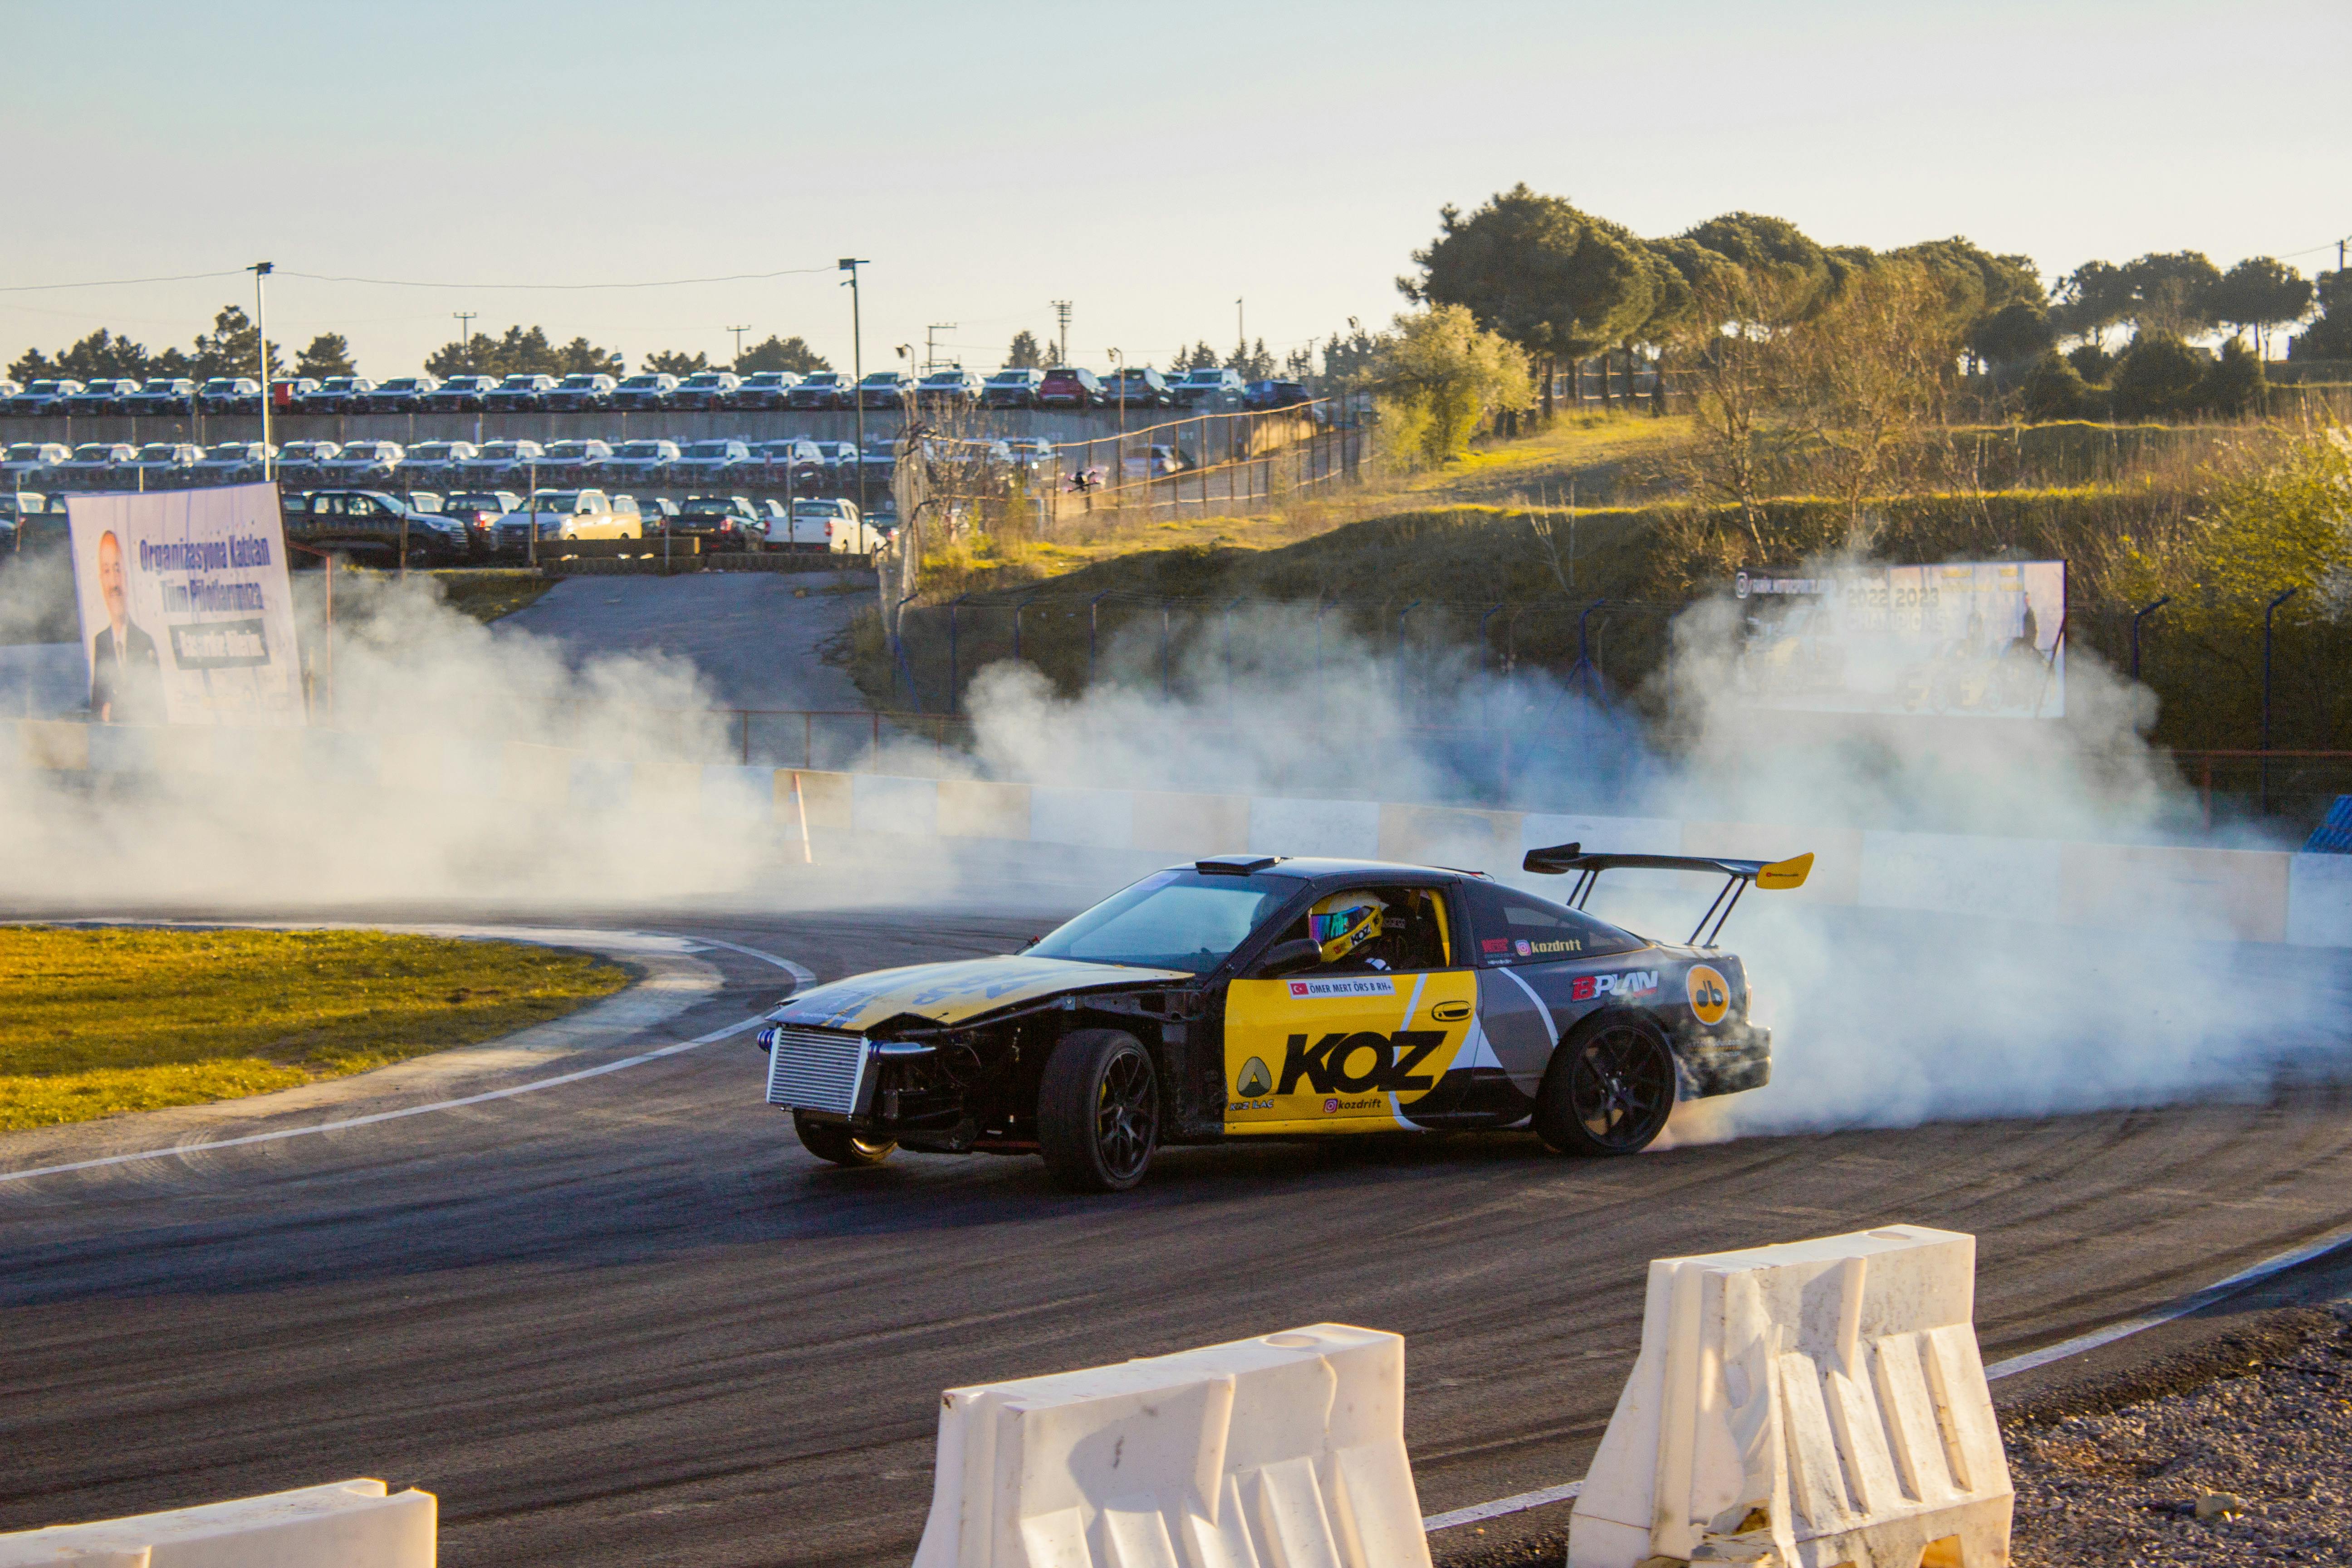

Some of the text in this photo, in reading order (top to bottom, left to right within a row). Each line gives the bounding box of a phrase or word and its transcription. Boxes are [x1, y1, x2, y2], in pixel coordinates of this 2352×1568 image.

[1847, 588, 1888, 608] 2022
[1896, 587, 1940, 608] 2023
[1351, 924, 1371, 946] KOZ
[1309, 981, 1392, 994] ÖMER MERT ÖRS B RH+
[1572, 970, 1658, 1001] BPLAN
[1276, 1030, 1448, 1095] KOZ
[1338, 1098, 1382, 1109] kozdrift
